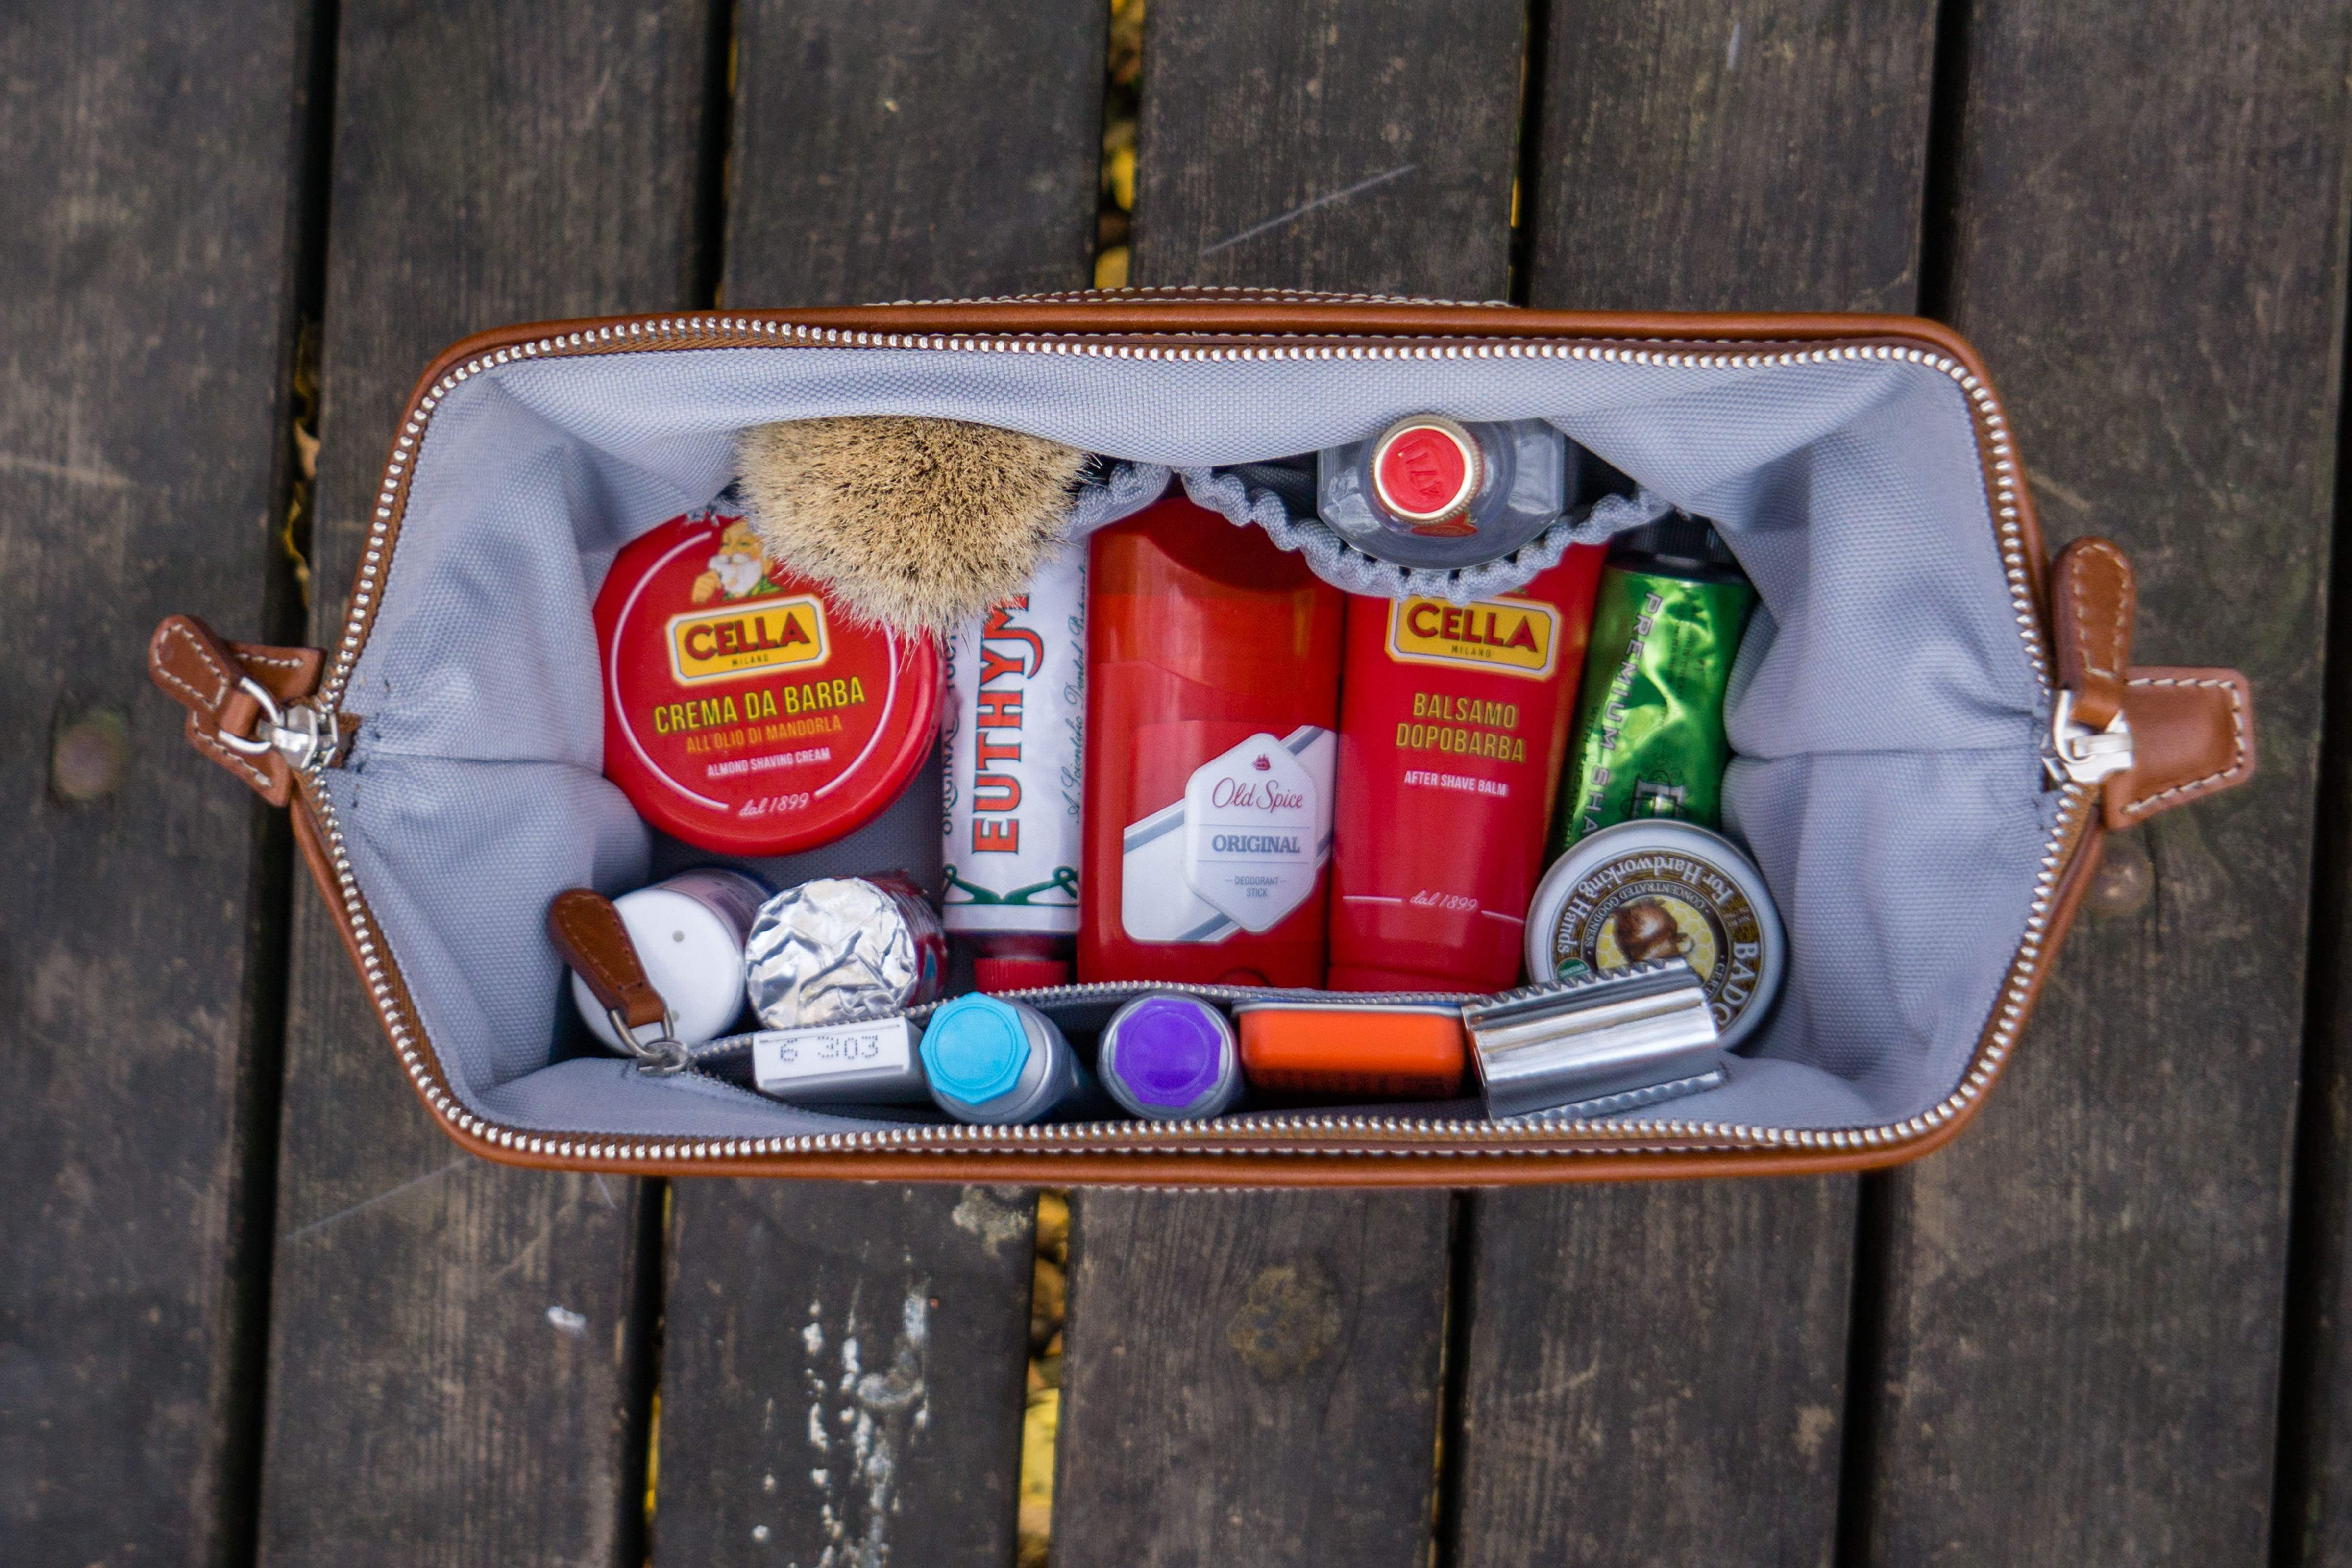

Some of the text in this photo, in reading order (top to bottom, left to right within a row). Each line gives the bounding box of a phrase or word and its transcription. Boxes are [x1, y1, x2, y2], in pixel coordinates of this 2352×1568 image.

[684, 611, 811, 660] CELLA
[1407, 602, 1538, 654] CELLA
[731, 654, 769, 667] MILANO
[1451, 644, 1492, 658] MILANO
[1600, 592, 1664, 751] PREMIUM
[654, 677, 865, 735] CREMA DA BARBA
[1413, 692, 1518, 729] BALSAMO
[748, 724, 762, 745] DI
[766, 715, 842, 742] MANDORLA
[1396, 723, 1526, 763] DOPOBARBA
[707, 747, 831, 777] ALMOND SHAVING CREAM
[1212, 777, 1303, 813] Old Spice
[1404, 770, 1508, 797] AFTER SHAVE BALM
[739, 792, 810, 817] dal 1899
[1212, 834, 1300, 853] ORIGINAL
[1235, 876, 1279, 886] DEODORANT
[1247, 888, 1267, 898] STICK
[1439, 893, 1478, 910] 1899
[1558, 856, 1735, 953] For Hardworking Hands
[1585, 882, 1704, 949] CONCENTRATED GOODNESS
